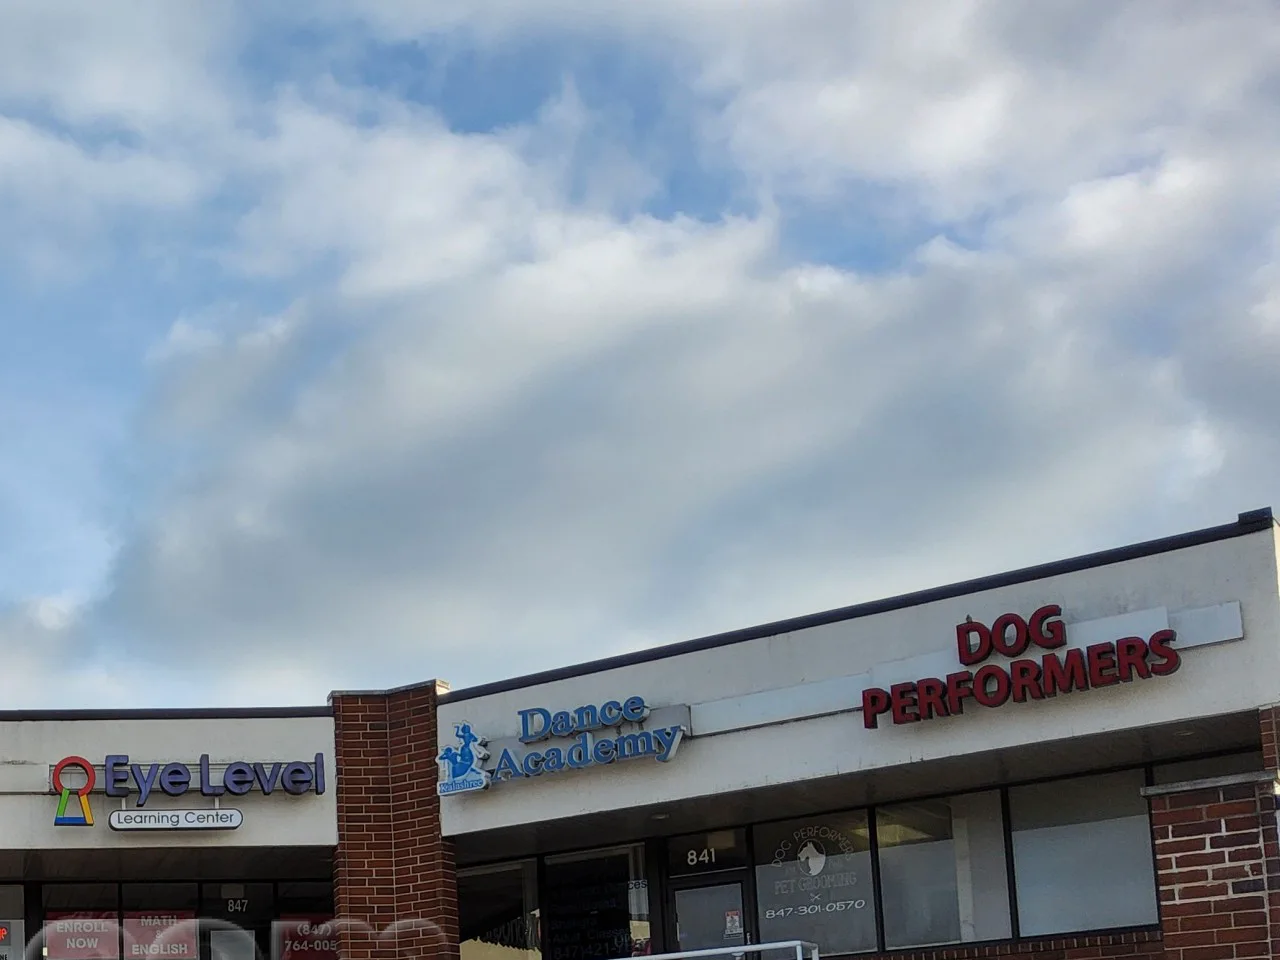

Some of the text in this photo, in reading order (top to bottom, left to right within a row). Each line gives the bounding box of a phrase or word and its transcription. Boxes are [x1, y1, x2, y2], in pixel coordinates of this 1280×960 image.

[956, 604, 1067, 666] DOG
[861, 628, 1181, 730] PERFORMERS
[517, 695, 646, 744] Dance
[493, 724, 686, 783] Academy
[117, 810, 234, 830] Learning Center
[687, 848, 716, 865] 841
[774, 880, 796, 895] PET
[227, 899, 248, 912] 847
[765, 899, 865, 919] 847-301-0570
[56, 922, 109, 933] ENROLL
[141, 915, 178, 926] MATH
[297, 923, 332, 937] (847)
[65, 938, 99, 949] NOW
[131, 943, 188, 955] ENGLISH
[284, 940, 337, 952] 764-005
